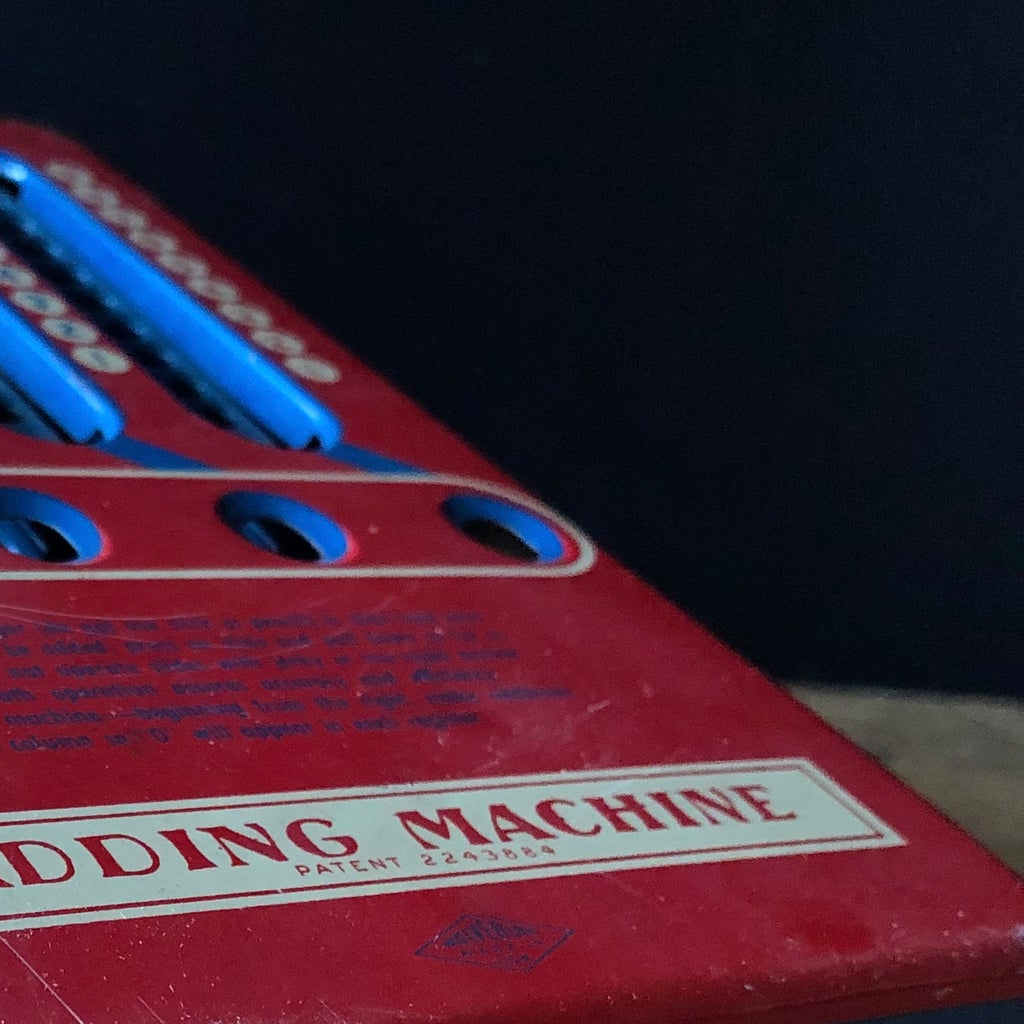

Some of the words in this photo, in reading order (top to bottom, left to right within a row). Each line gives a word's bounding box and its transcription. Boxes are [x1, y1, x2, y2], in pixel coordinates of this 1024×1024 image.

[395, 783, 797, 851] MACHINE
[294, 856, 401, 877] PATENT
[421, 844, 556, 867] 2243884
